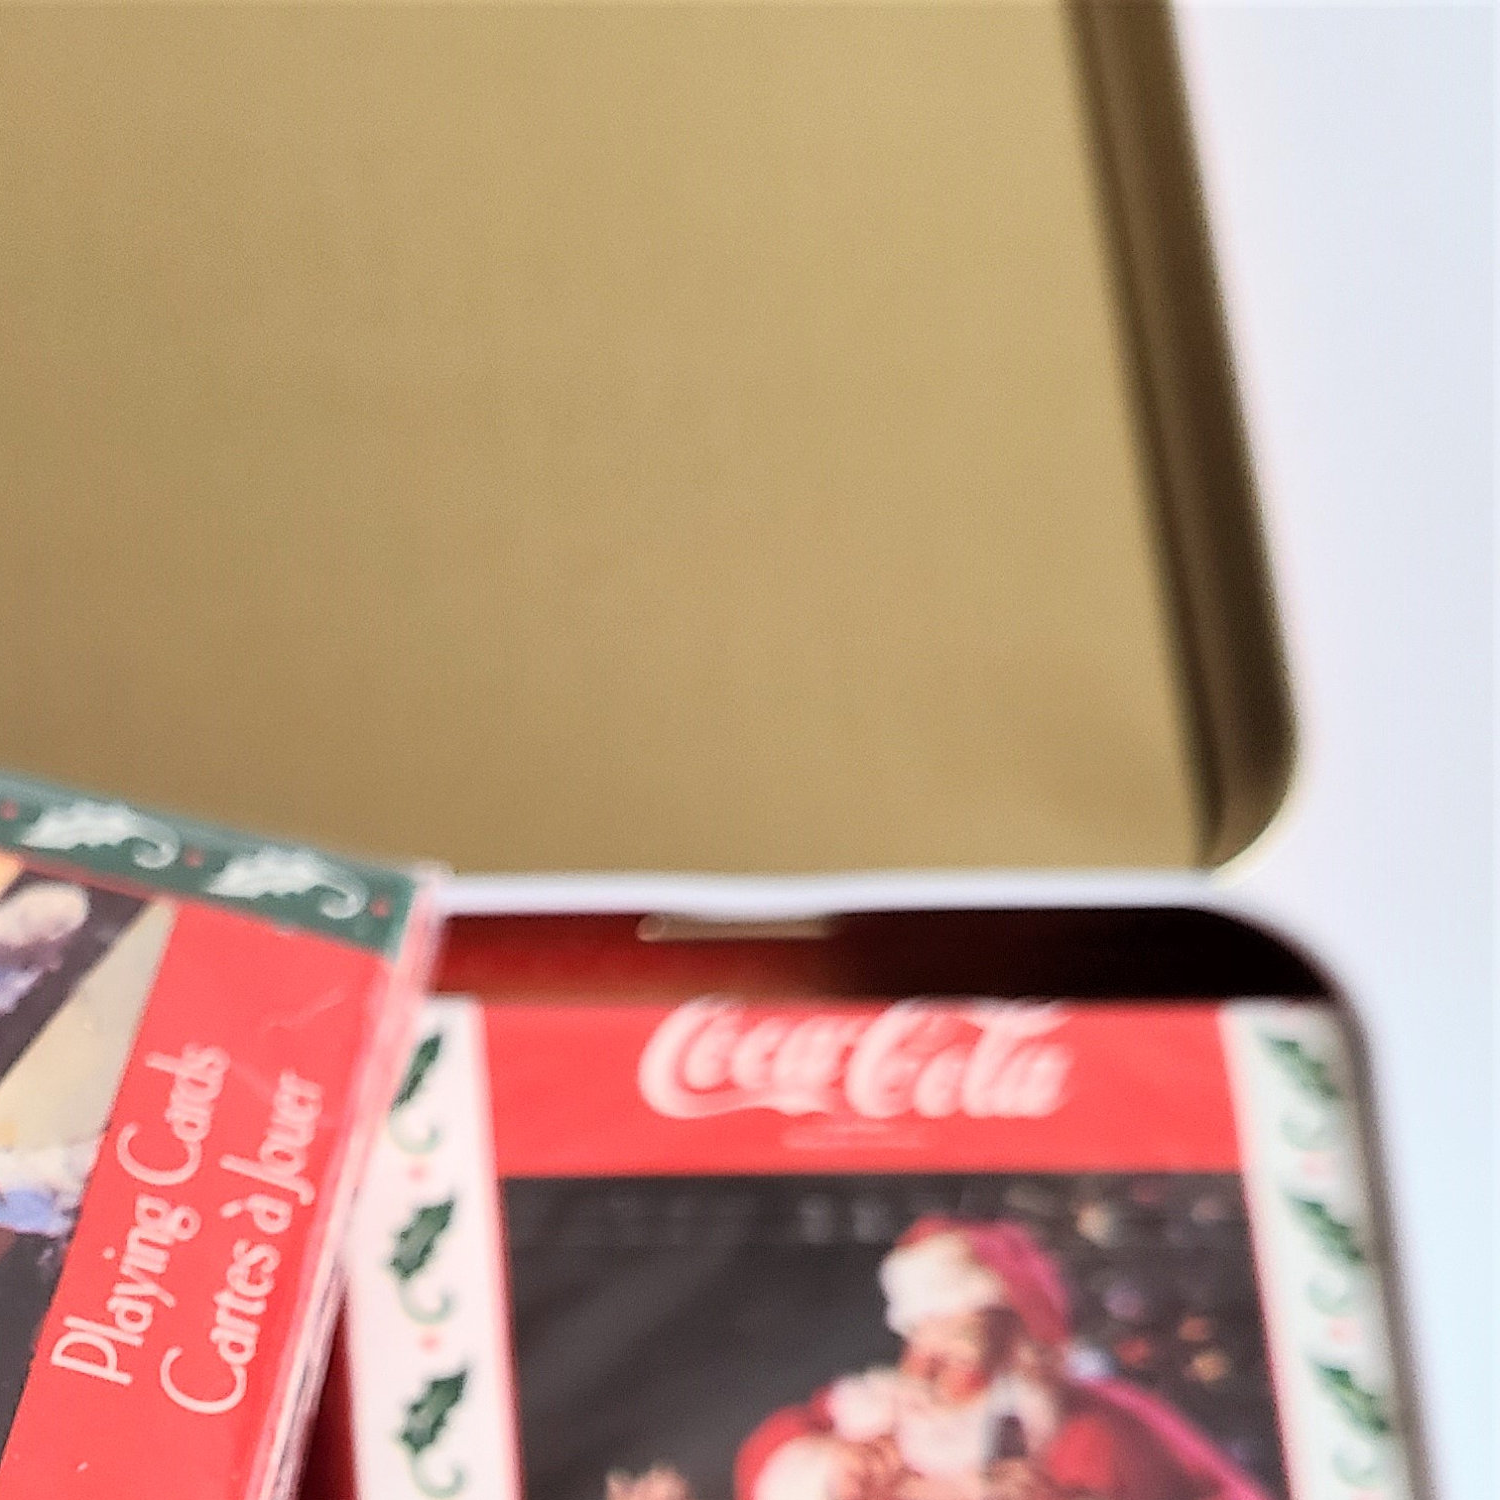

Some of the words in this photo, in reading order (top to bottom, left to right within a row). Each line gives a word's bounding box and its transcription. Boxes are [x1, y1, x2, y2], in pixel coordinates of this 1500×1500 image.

[115, 1042, 231, 1186] Cards
[219, 1068, 324, 1207] Jouer
[219, 1192, 293, 1235] à
[50, 1192, 202, 1386] Playing
[159, 1238, 282, 1416] Cartes
